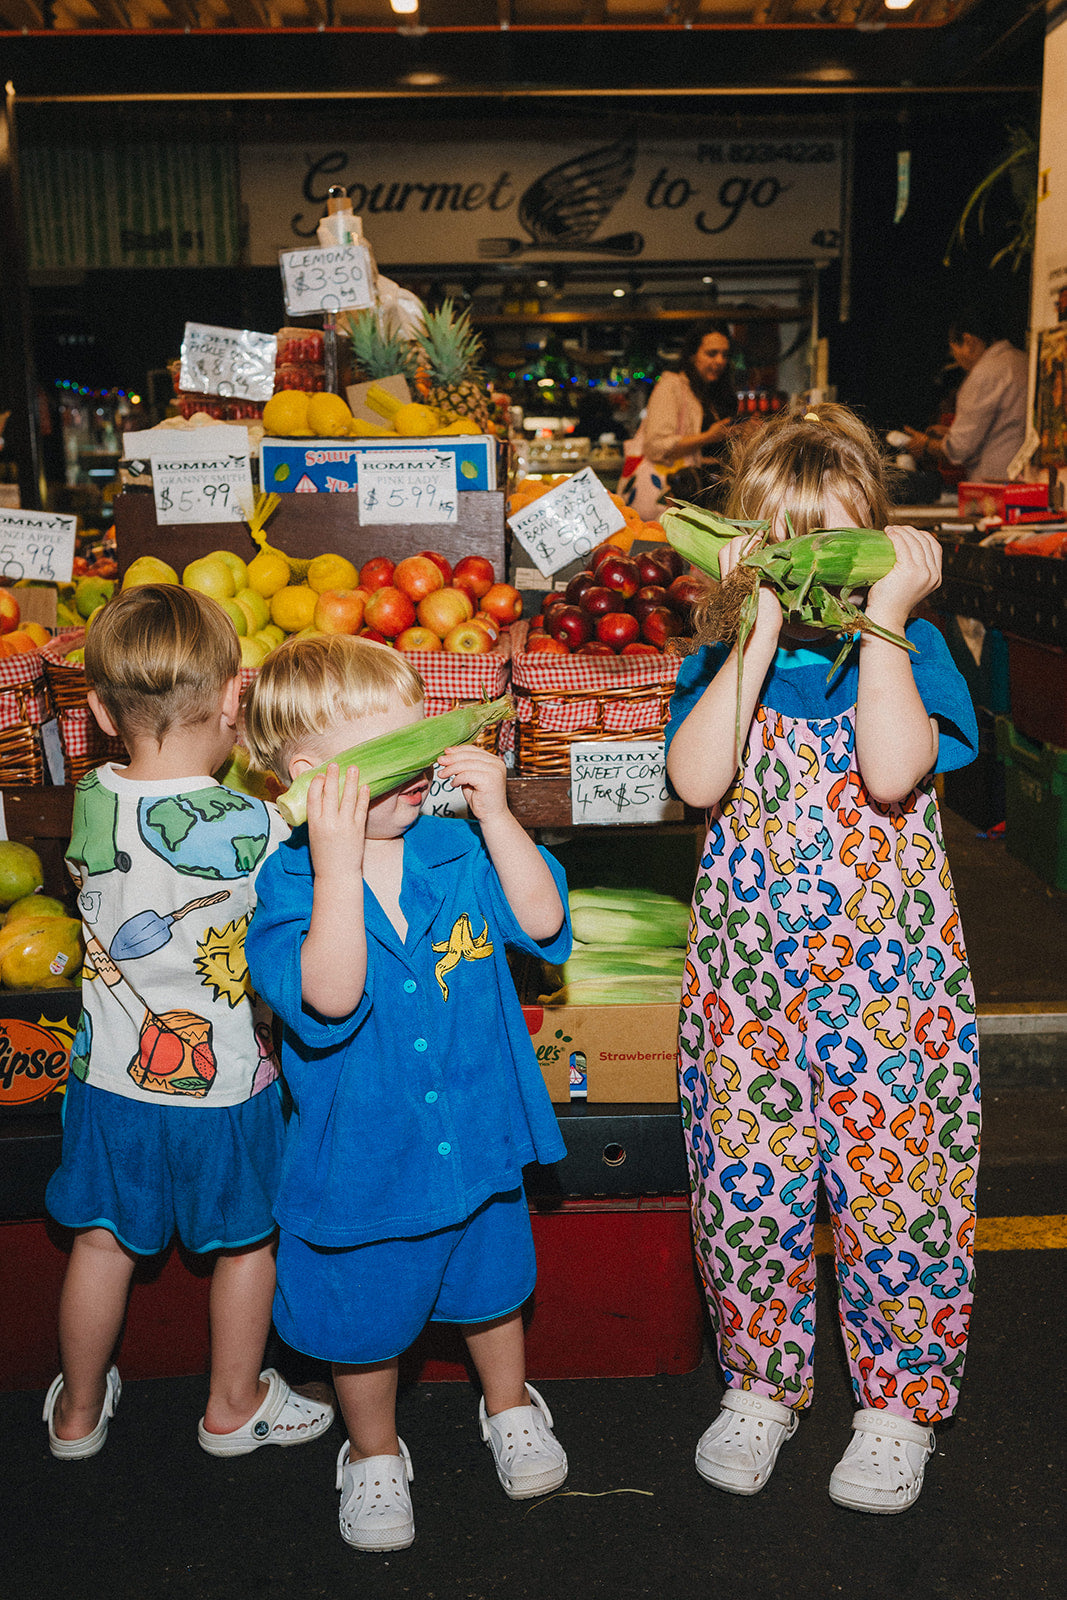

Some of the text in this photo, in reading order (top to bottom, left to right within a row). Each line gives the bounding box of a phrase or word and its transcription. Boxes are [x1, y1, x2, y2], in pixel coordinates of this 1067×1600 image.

[291, 151, 791, 237] Gourmet to go
[289, 248, 355, 269] LEMONS
[573, 764, 624, 782] SWEET
[577, 784, 592, 814] 4
[599, 1050, 677, 1061] Strawberries
